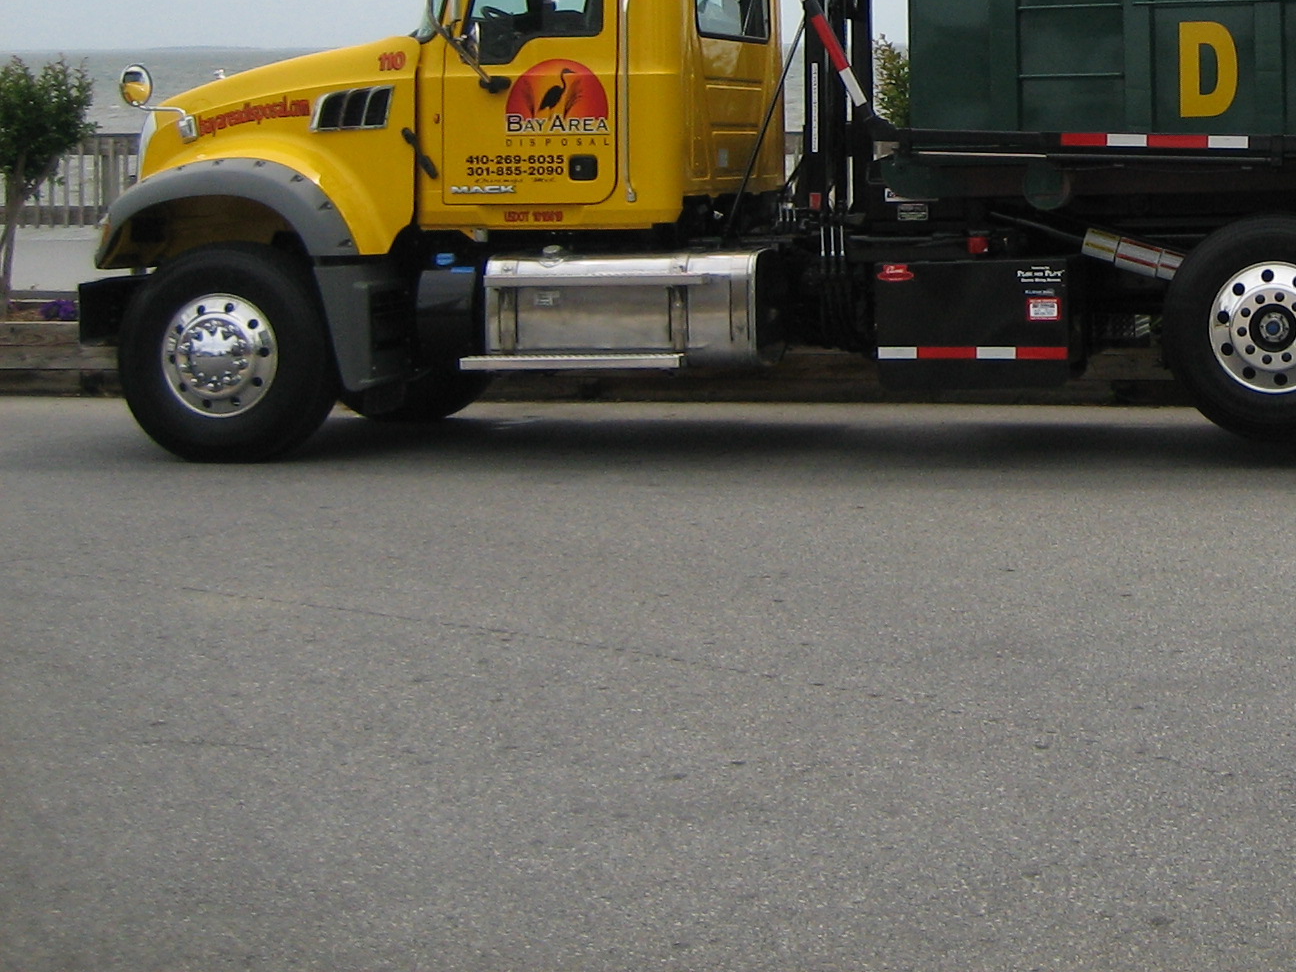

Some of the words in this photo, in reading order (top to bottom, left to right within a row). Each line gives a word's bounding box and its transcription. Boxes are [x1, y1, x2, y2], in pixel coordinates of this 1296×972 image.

[378, 51, 406, 71] 110
[506, 115, 547, 133] BAY
[549, 114, 609, 132] AREA
[505, 137, 610, 147] DISPOSAL
[466, 154, 565, 165] 410-269-6035
[467, 166, 565, 176] 301-855-2090
[450, 185, 516, 194] MACK
